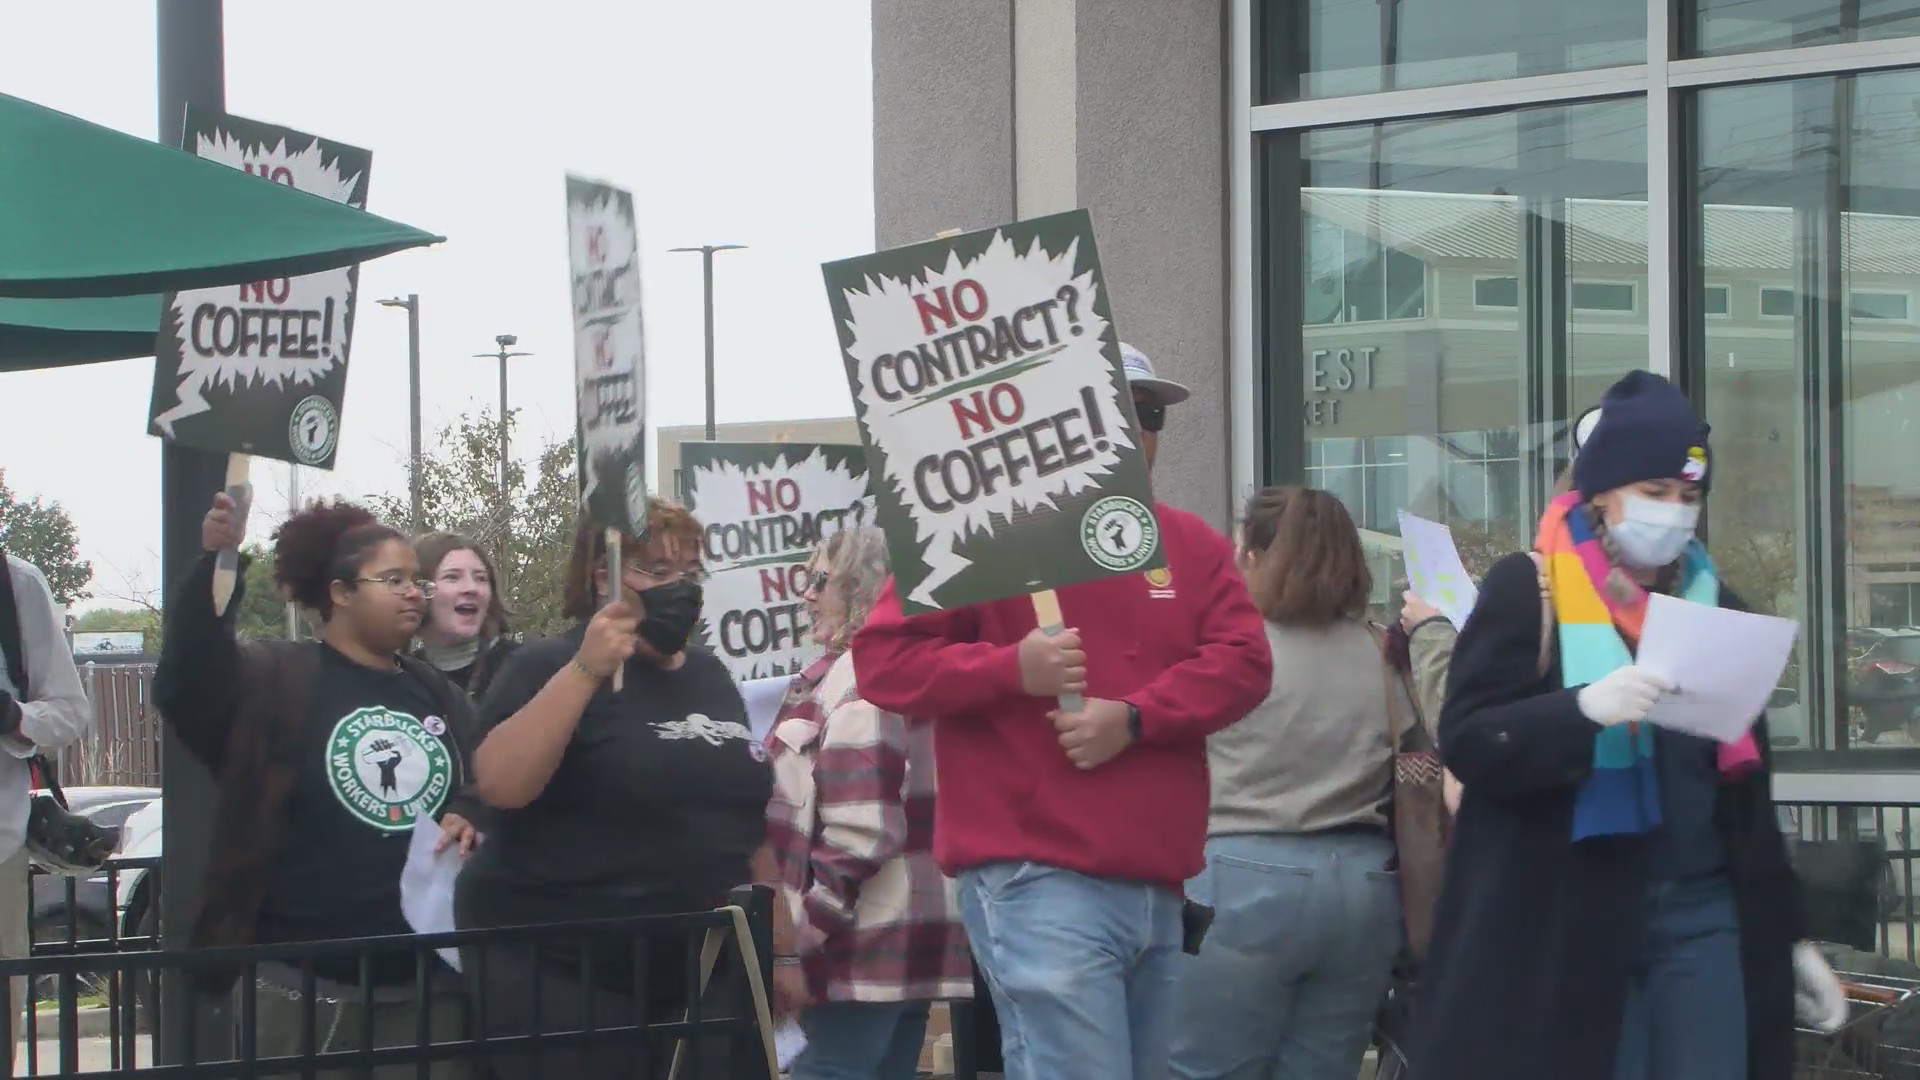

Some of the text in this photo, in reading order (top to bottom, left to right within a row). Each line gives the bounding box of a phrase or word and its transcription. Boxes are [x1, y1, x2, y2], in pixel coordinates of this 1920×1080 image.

[239, 278, 290, 304] NO
[912, 279, 988, 336] NO
[191, 297, 335, 359] COFFEE!
[871, 285, 1084, 402] CONTRACT?
[949, 382, 1024, 440] NO
[914, 386, 1110, 514] COFFEE!
[746, 478, 800, 515] NO
[759, 564, 809, 603] NO
[720, 604, 809, 658] COFF
[346, 713, 438, 752] STARBUCKS
[333, 752, 388, 817] WORKERS
